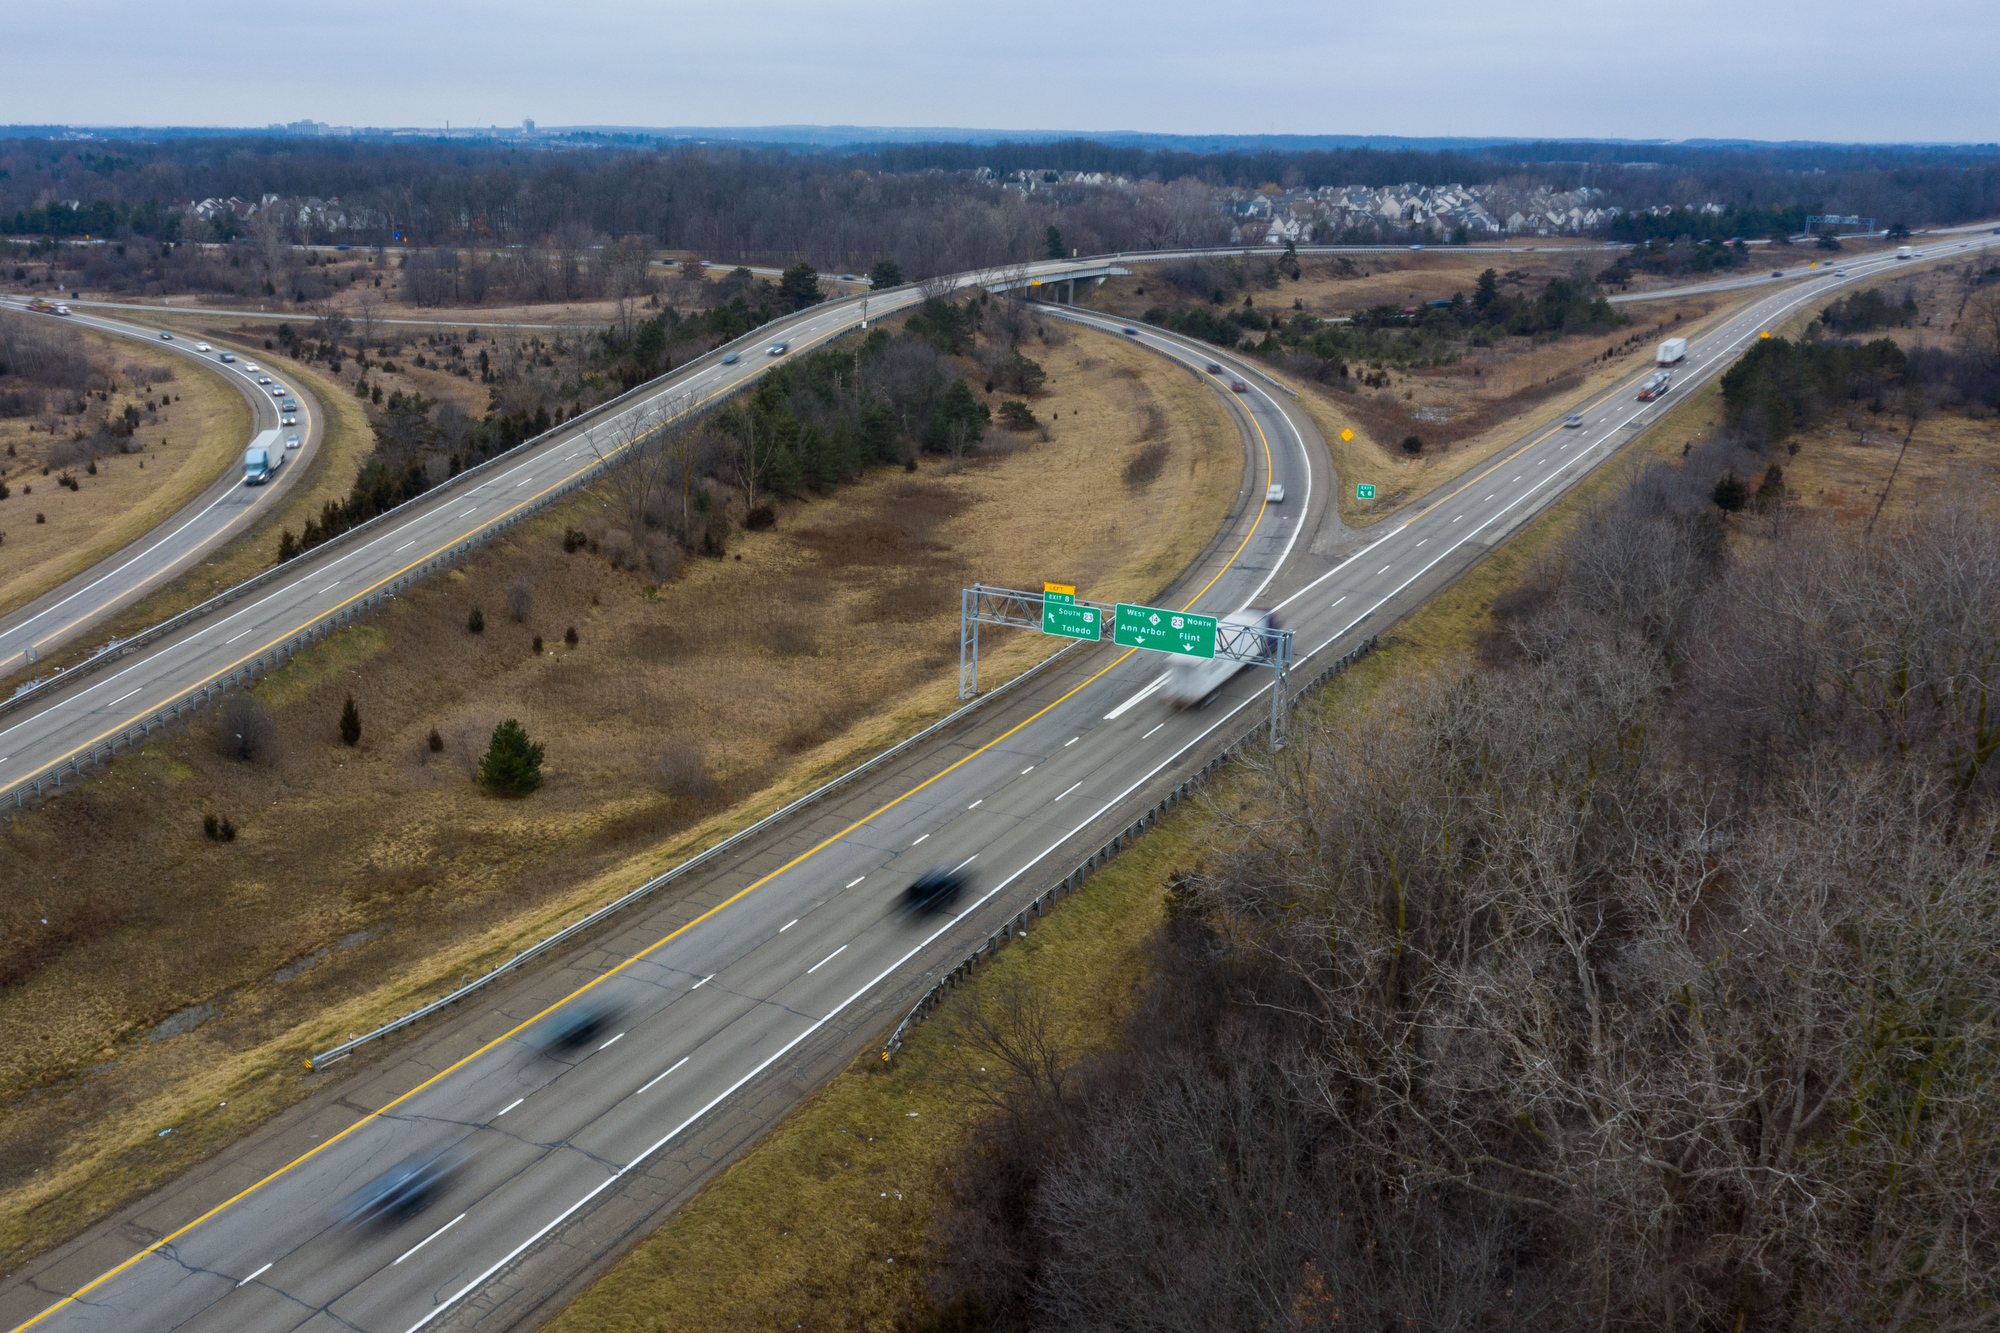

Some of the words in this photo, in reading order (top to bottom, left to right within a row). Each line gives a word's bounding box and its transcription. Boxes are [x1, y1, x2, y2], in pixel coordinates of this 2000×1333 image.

[1058, 608, 1080, 617] SOUTH
[1127, 609, 1145, 617] WEST
[1172, 618, 1183, 627] 23
[1187, 618, 1212, 627] NORTH
[1062, 624, 1091, 634] Toledo
[1120, 624, 1138, 632] Ann
[1140, 626, 1166, 636] Arbor
[1179, 632, 1200, 642] Flint
